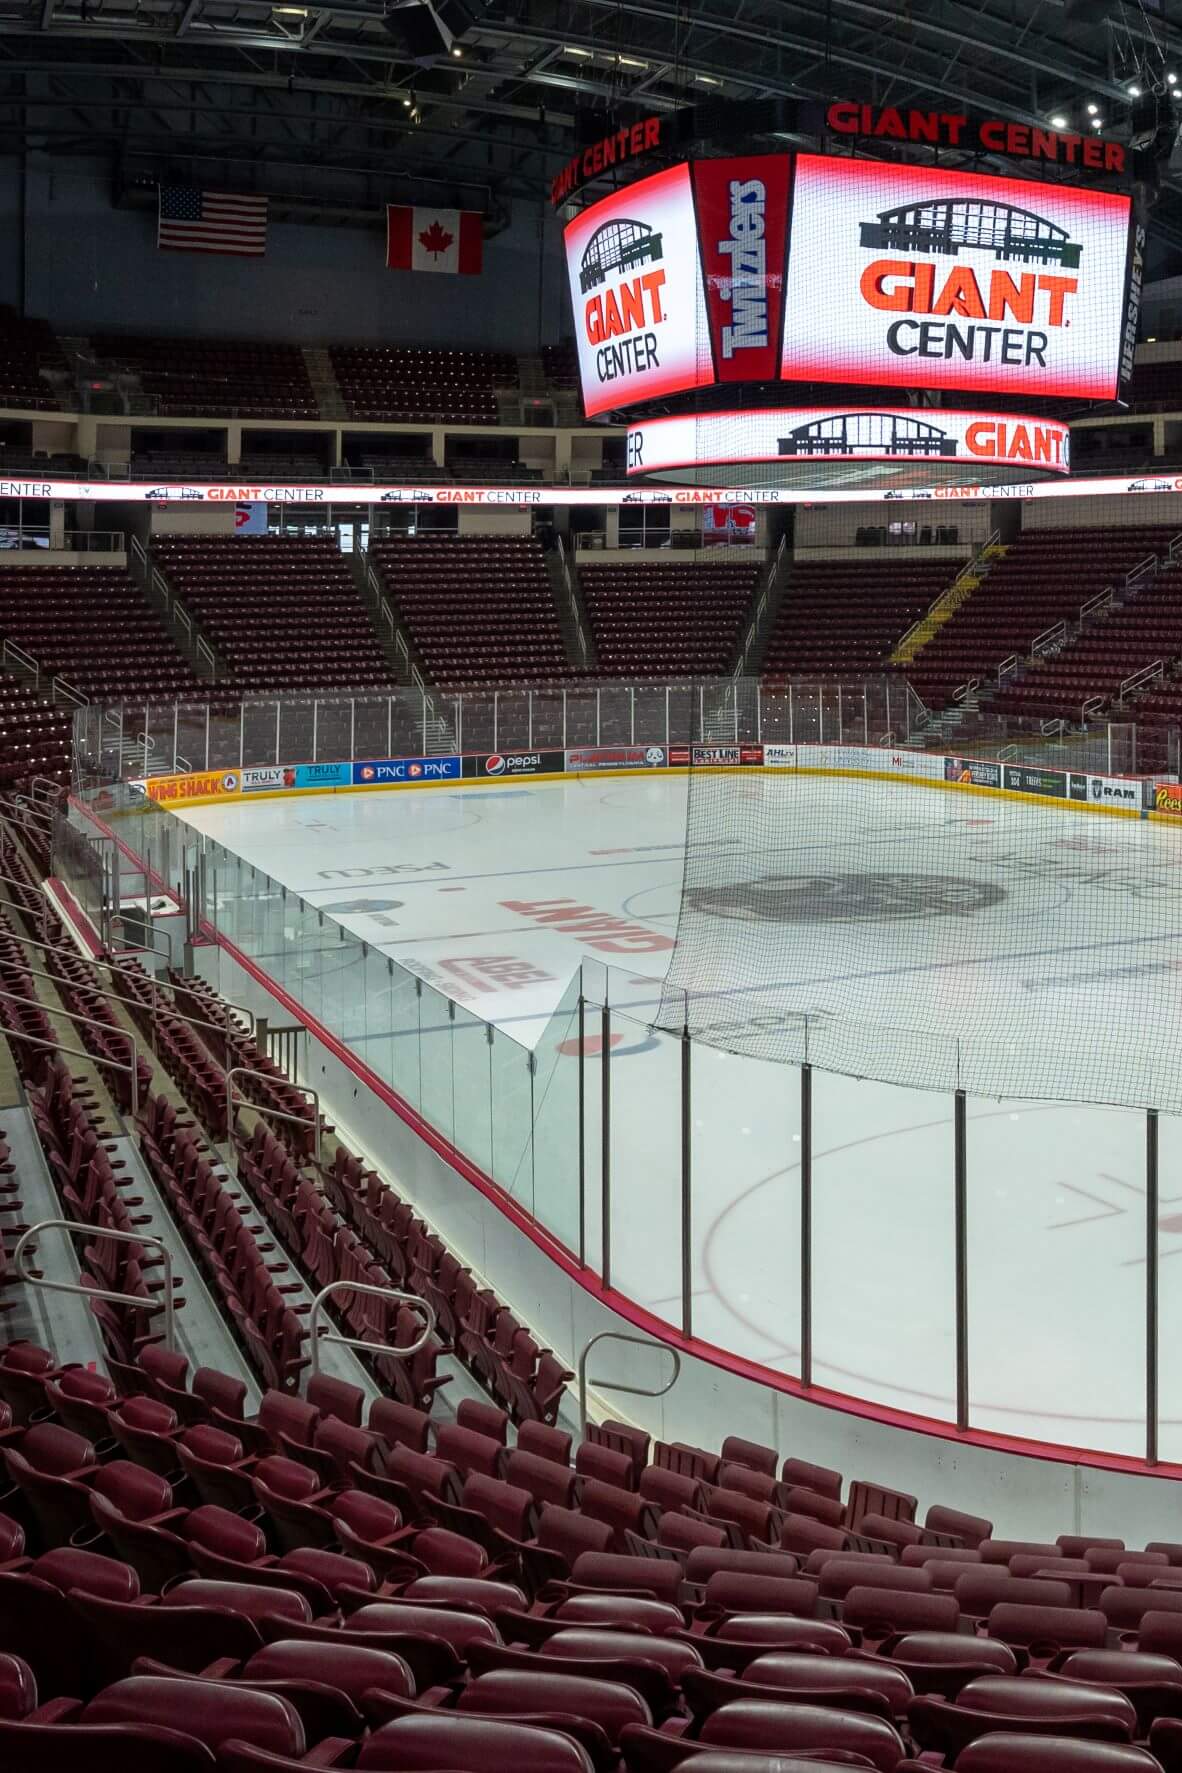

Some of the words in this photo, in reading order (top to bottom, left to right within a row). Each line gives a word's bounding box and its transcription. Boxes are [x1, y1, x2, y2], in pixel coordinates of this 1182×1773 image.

[827, 102, 968, 144] GIANT
[979, 121, 1126, 172] CENTER
[583, 116, 662, 177] CENTER
[719, 179, 768, 359] Twizzlers
[860, 259, 1078, 328] GIANT
[585, 268, 666, 346] GIANT
[887, 319, 1048, 367] CENTER
[596, 332, 660, 383] CENTER
[965, 421, 1063, 466] GIANT
[0, 482, 51, 497] ENTER
[207, 489, 261, 500] GIANT
[263, 489, 324, 501] CENTER
[436, 491, 485, 501] GIANT
[487, 491, 541, 502] CENTER
[675, 492, 723, 502] GIANT
[725, 491, 779, 502] CENTER
[934, 488, 980, 498] GIANT
[982, 486, 1034, 497] CENTER
[506, 754, 540, 768] pepsi
[307, 765, 341, 776] TRULY
[377, 766, 404, 778] PNC
[424, 763, 451, 774] PNC
[243, 770, 281, 782] TRULY
[1104, 786, 1136, 799] RAM
